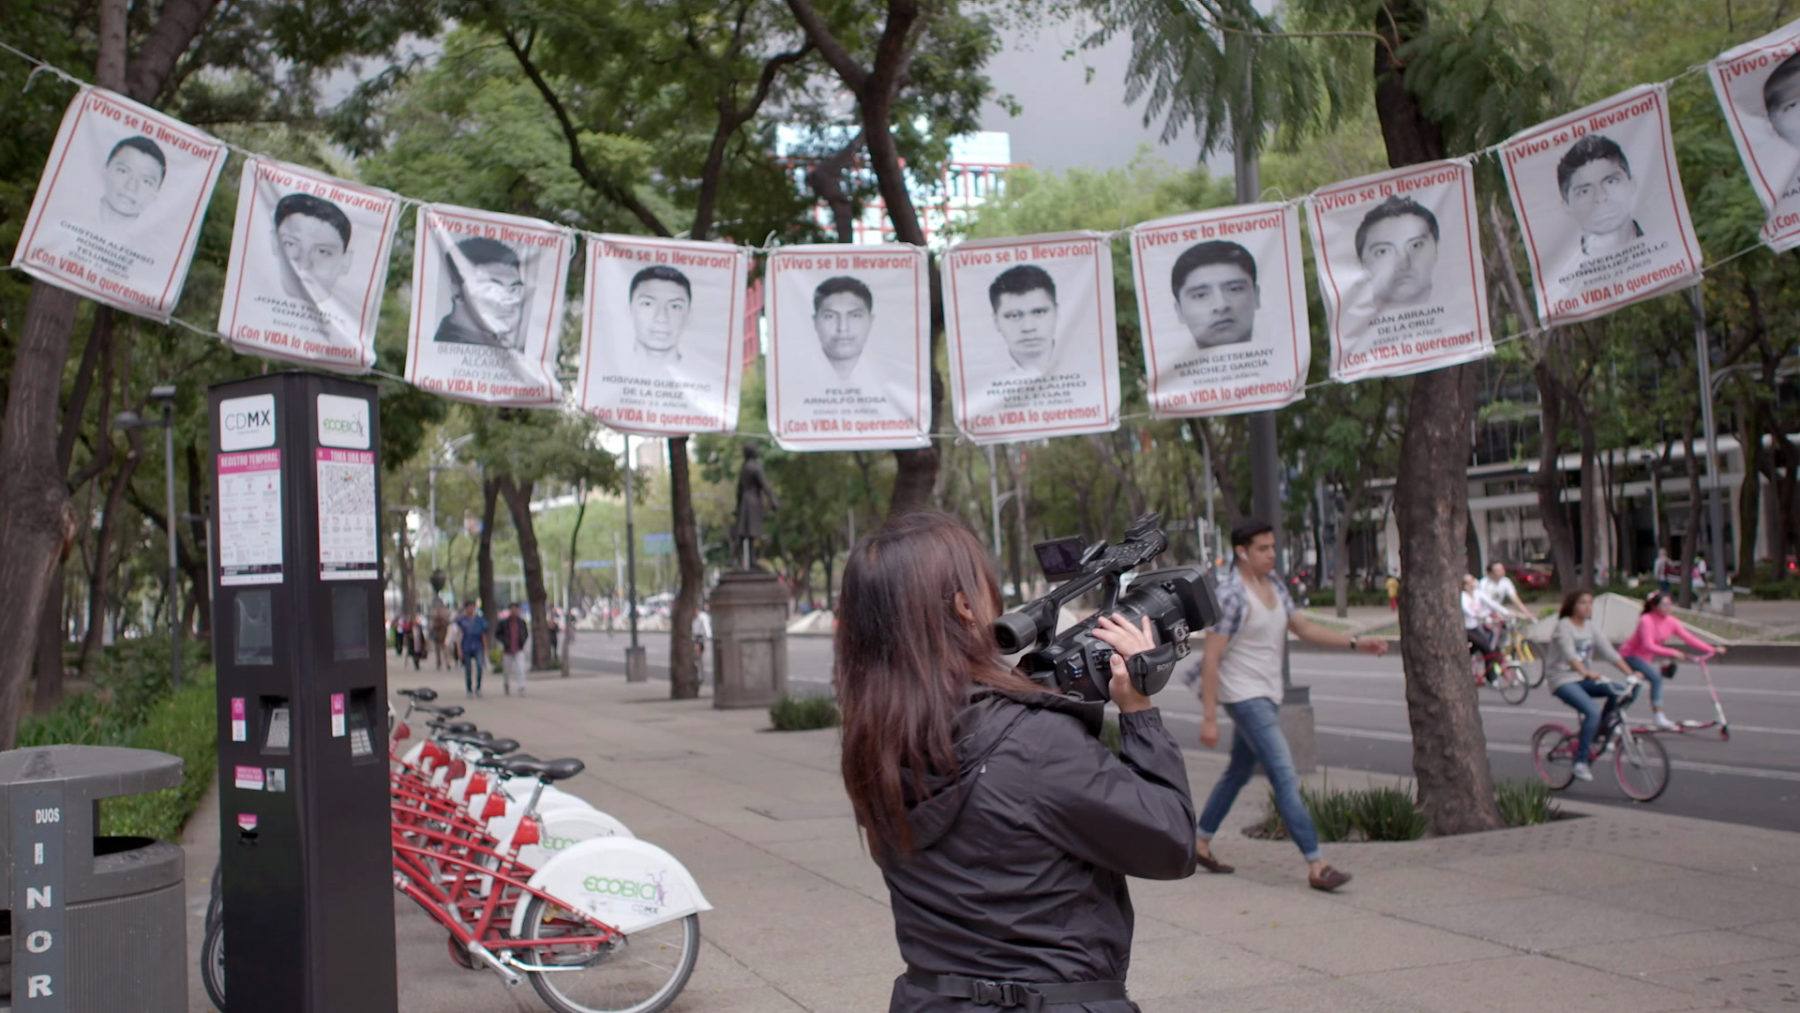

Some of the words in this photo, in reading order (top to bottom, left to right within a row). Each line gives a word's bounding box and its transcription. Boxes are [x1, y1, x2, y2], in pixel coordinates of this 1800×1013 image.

[1726, 55, 1769, 82] ¡Vivo
[86, 98, 121, 119] ¡Vivo
[124, 114, 138, 128] se
[141, 120, 153, 134] lo
[156, 126, 212, 159] llevaron!
[1511, 139, 1549, 163] ¡Vivo
[1552, 131, 1568, 145] se
[1572, 125, 1586, 138] lo
[1589, 98, 1653, 132] llevaron!
[296, 180, 310, 191] se
[313, 184, 326, 197] lo
[329, 186, 386, 213] llevaron!
[1320, 193, 1356, 214] ¡Vivo
[1360, 188, 1375, 201] se
[1380, 183, 1392, 197] lo
[1396, 168, 1458, 193] llevaron!
[466, 223, 480, 236] se
[484, 225, 496, 239] lo
[500, 226, 558, 248] llevaron!
[1142, 232, 1178, 249] ¡Vivo
[1182, 229, 1197, 240] se
[1201, 224, 1215, 238] lo
[1219, 215, 1280, 236] llevaron!
[636, 249, 651, 261] se
[655, 250, 667, 263] lo
[672, 250, 731, 269] llevaron!
[778, 256, 812, 272] ¡Vivo
[816, 259, 831, 270] se
[836, 256, 848, 270] lo
[853, 255, 912, 269] llevaron!
[956, 250, 992, 269] ¡Vivo
[996, 251, 1009, 263] se
[1015, 248, 1027, 261] lo
[1032, 241, 1092, 260] llevaron!
[31, 248, 56, 266] ¡Con
[59, 257, 84, 277] VIDA
[87, 269, 97, 283] lo
[99, 277, 155, 308] queremos!
[1554, 299, 1579, 315] ¡Con
[1581, 286, 1611, 304] VIDA
[1613, 283, 1624, 296] lo
[1626, 260, 1685, 292] queremos!
[1378, 326, 1391, 335] DE
[1394, 323, 1407, 333] LA
[236, 325, 259, 340] ¡Con
[264, 329, 288, 346] VIDA
[290, 336, 300, 349] lo
[303, 341, 356, 359] queremos!
[1344, 352, 1367, 368] ¡Con
[1369, 344, 1399, 360] VIDA
[1401, 342, 1412, 355] lo
[1416, 331, 1474, 354] queremos!
[447, 378, 472, 392] VIDA
[477, 380, 487, 393] lo
[490, 383, 544, 397] queremos!
[622, 387, 637, 396] DE
[640, 388, 652, 397] LA
[1190, 387, 1217, 402] VIDA
[1220, 386, 1231, 400] lo
[1234, 379, 1292, 399] queremos!
[225, 410, 271, 431] CDMX
[616, 407, 643, 423] VIDA
[646, 409, 657, 423] lo
[660, 411, 718, 427] queremos!
[784, 419, 808, 434] ¡Con
[812, 419, 839, 432] VIDA
[842, 419, 852, 432] lo
[854, 417, 914, 433] queremos!
[999, 410, 1025, 425] VIDA
[1028, 409, 1039, 423] lo
[1042, 405, 1100, 423] queremos!
[35, 808, 59, 824] DUOS
